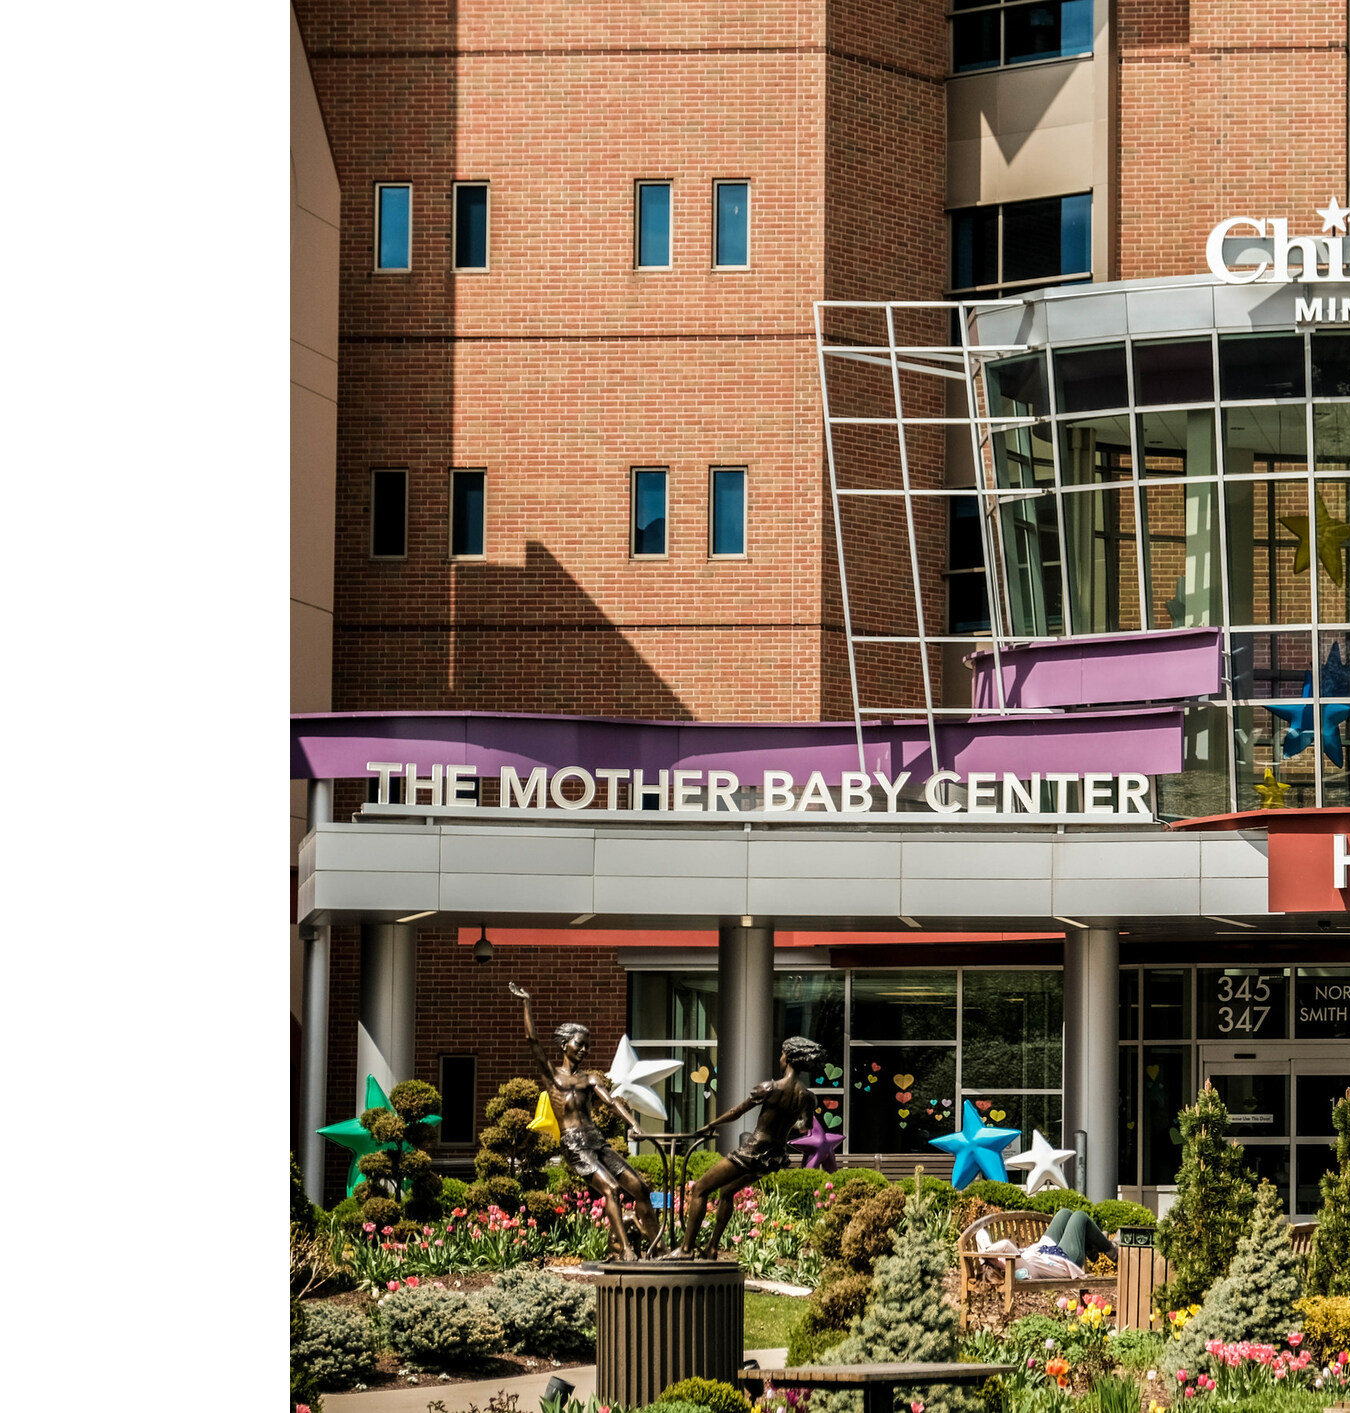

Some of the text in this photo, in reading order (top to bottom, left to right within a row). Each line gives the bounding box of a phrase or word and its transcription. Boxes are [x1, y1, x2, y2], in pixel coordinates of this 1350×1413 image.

[366, 762, 1151, 814] THE MOTHER BABY CENTER
[1217, 976, 1270, 1002] 345
[1218, 1006, 1271, 1033] 347
[1300, 1007, 1347, 1022] SMITH
